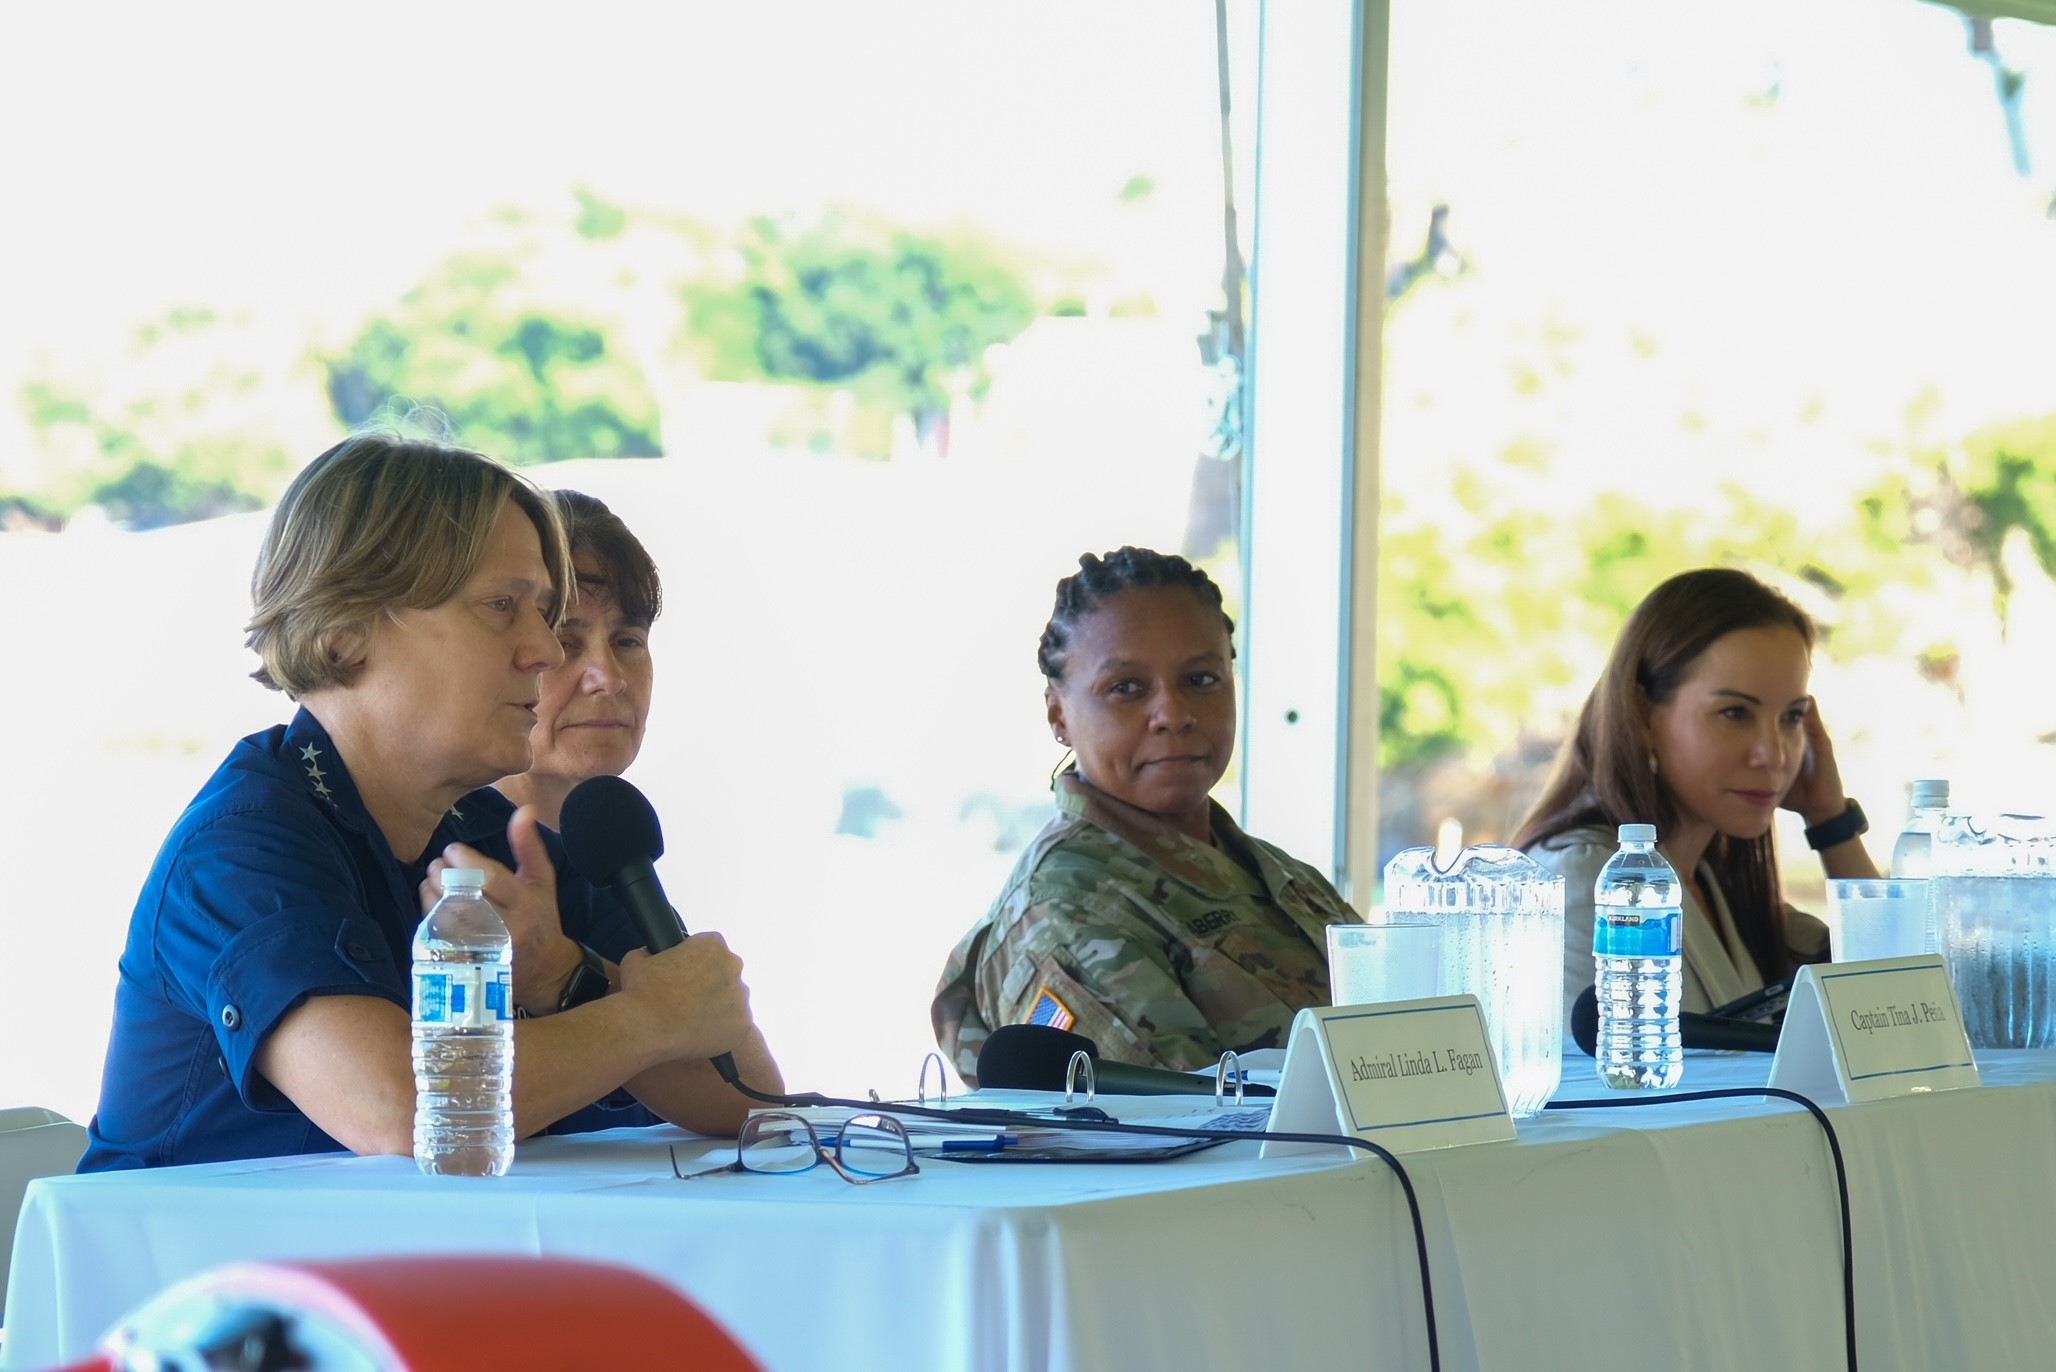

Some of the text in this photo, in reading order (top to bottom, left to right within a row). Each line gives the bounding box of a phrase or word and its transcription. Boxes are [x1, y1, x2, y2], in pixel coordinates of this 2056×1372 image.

[1850, 1006, 1890, 1035] Captain
[1887, 1004, 1911, 1027] Tina
[1911, 1003, 1923, 1025] J.
[1351, 1049, 1483, 1082] Admiral Linda L. Fagan
